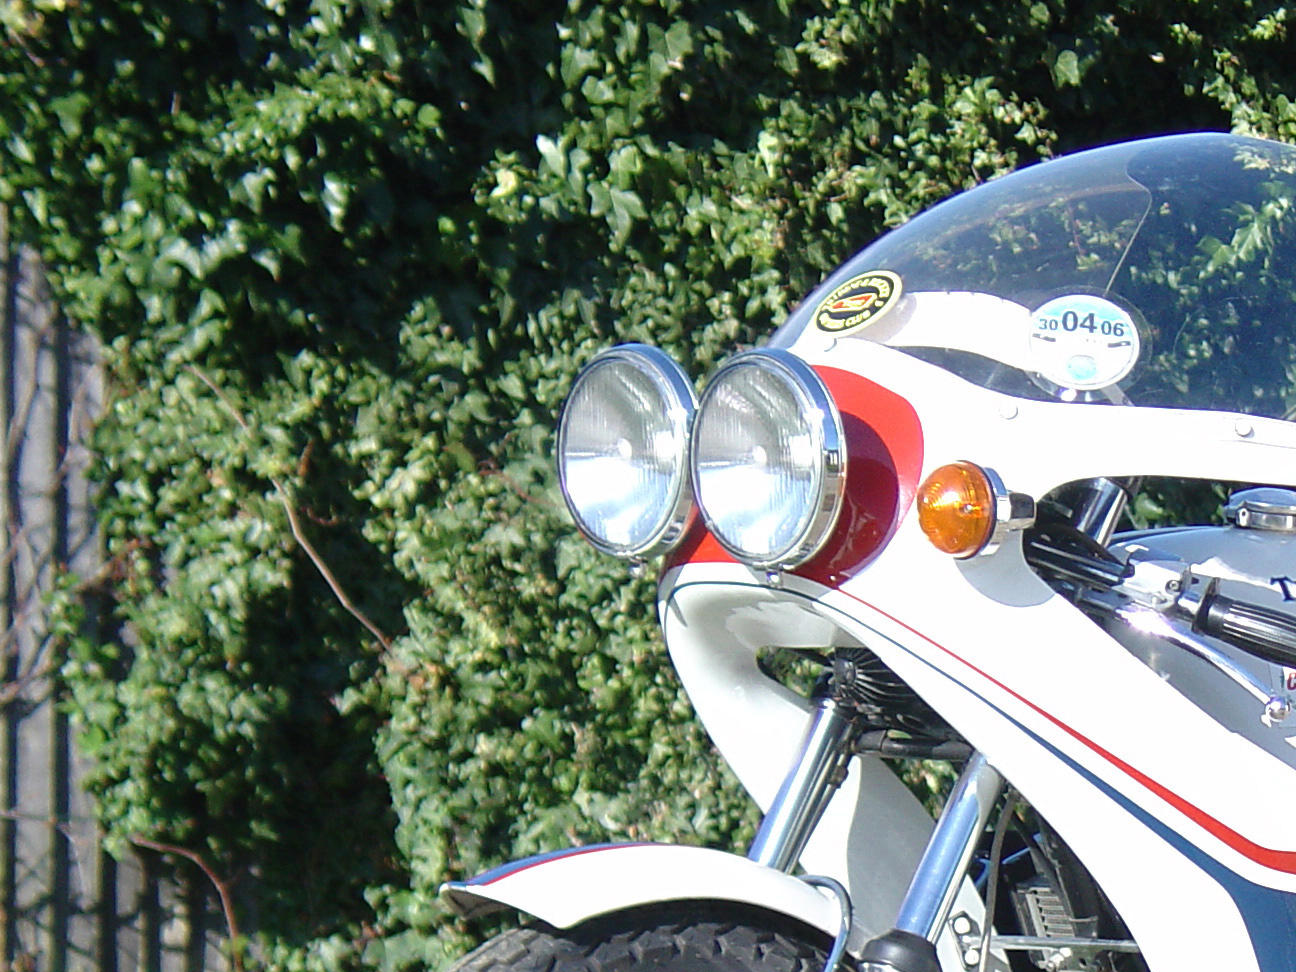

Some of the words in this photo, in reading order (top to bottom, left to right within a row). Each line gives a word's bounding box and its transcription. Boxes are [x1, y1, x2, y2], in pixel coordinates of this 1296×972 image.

[1038, 318, 1058, 331] 30
[1061, 310, 1098, 334] 04
[1100, 320, 1124, 337] 06
